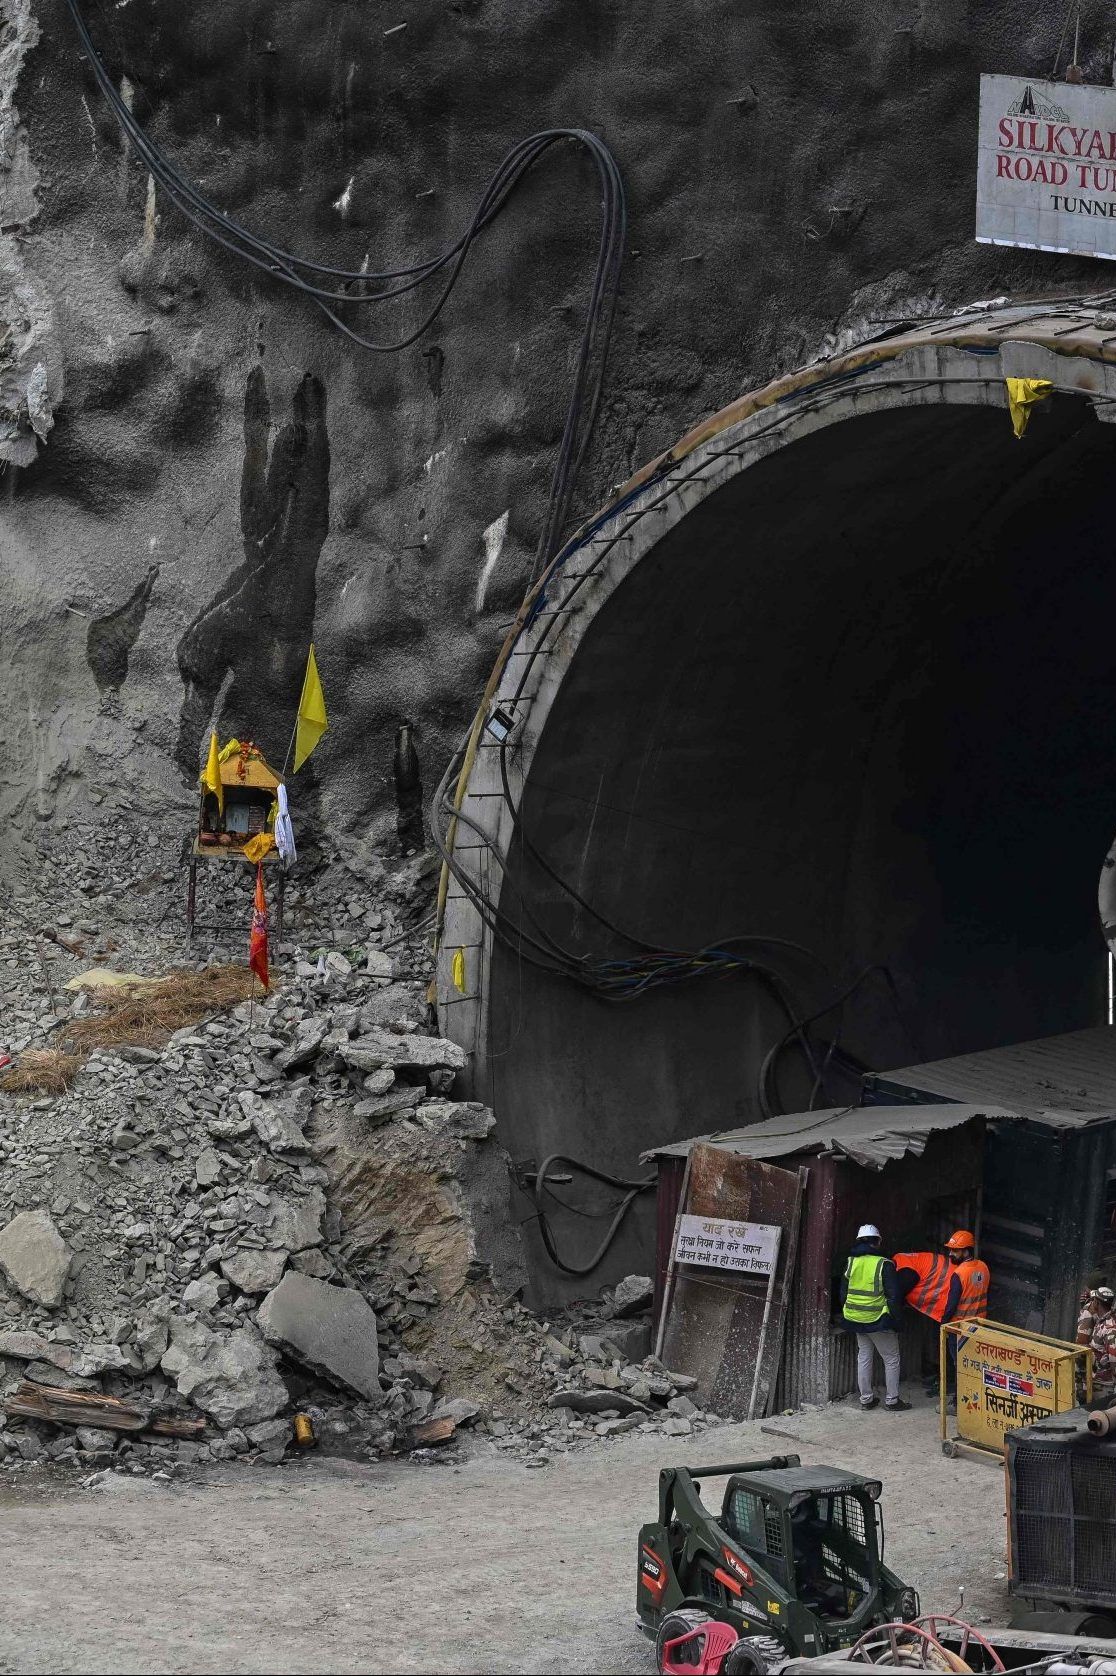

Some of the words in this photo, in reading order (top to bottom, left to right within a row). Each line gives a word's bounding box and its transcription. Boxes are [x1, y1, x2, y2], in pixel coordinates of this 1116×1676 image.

[996, 154, 1068, 186] ROAD
[702, 1222, 725, 1235] याद
[696, 1235, 714, 1249] नियम
[715, 1237, 726, 1250] जो
[742, 1243, 763, 1255] सफल
[712, 1254, 720, 1263] न
[720, 1253, 730, 1267] हो
[975, 1340, 1027, 1366] उत्तराखण्ड
[1026, 1354, 1056, 1374] पुलि
